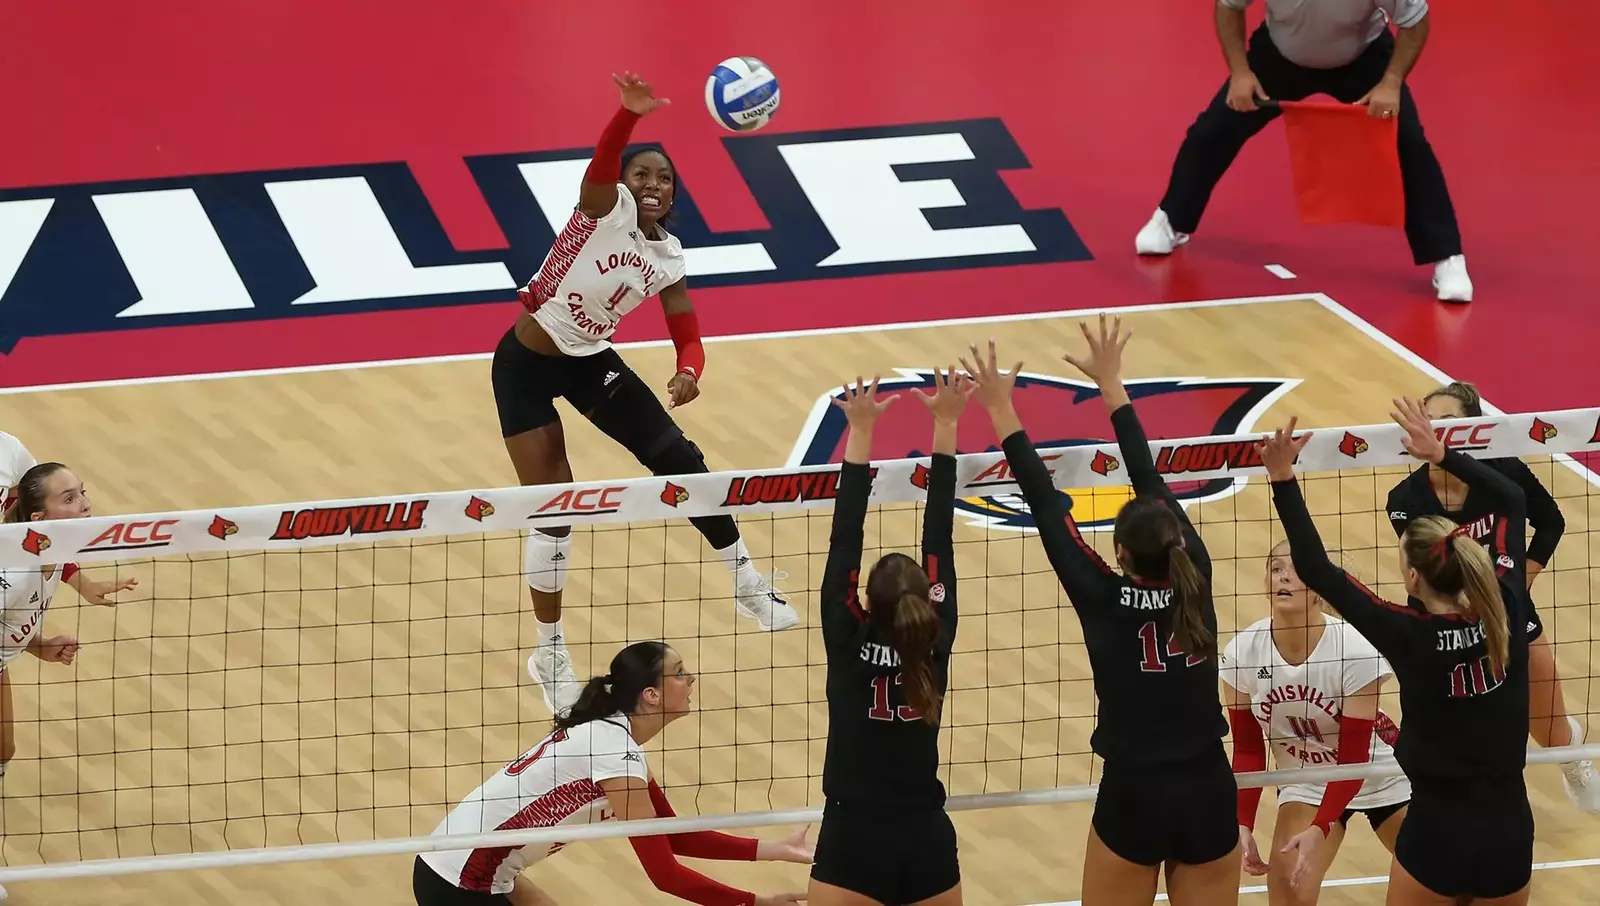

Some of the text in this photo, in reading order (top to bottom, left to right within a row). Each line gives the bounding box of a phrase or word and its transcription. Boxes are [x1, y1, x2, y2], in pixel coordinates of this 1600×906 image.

[536, 486, 629, 513] ACC
[720, 467, 879, 507] LOUISVIL
[84, 519, 180, 547] ACC
[268, 500, 429, 541] LOUISVILLE
[1120, 586, 1174, 610] STANF
